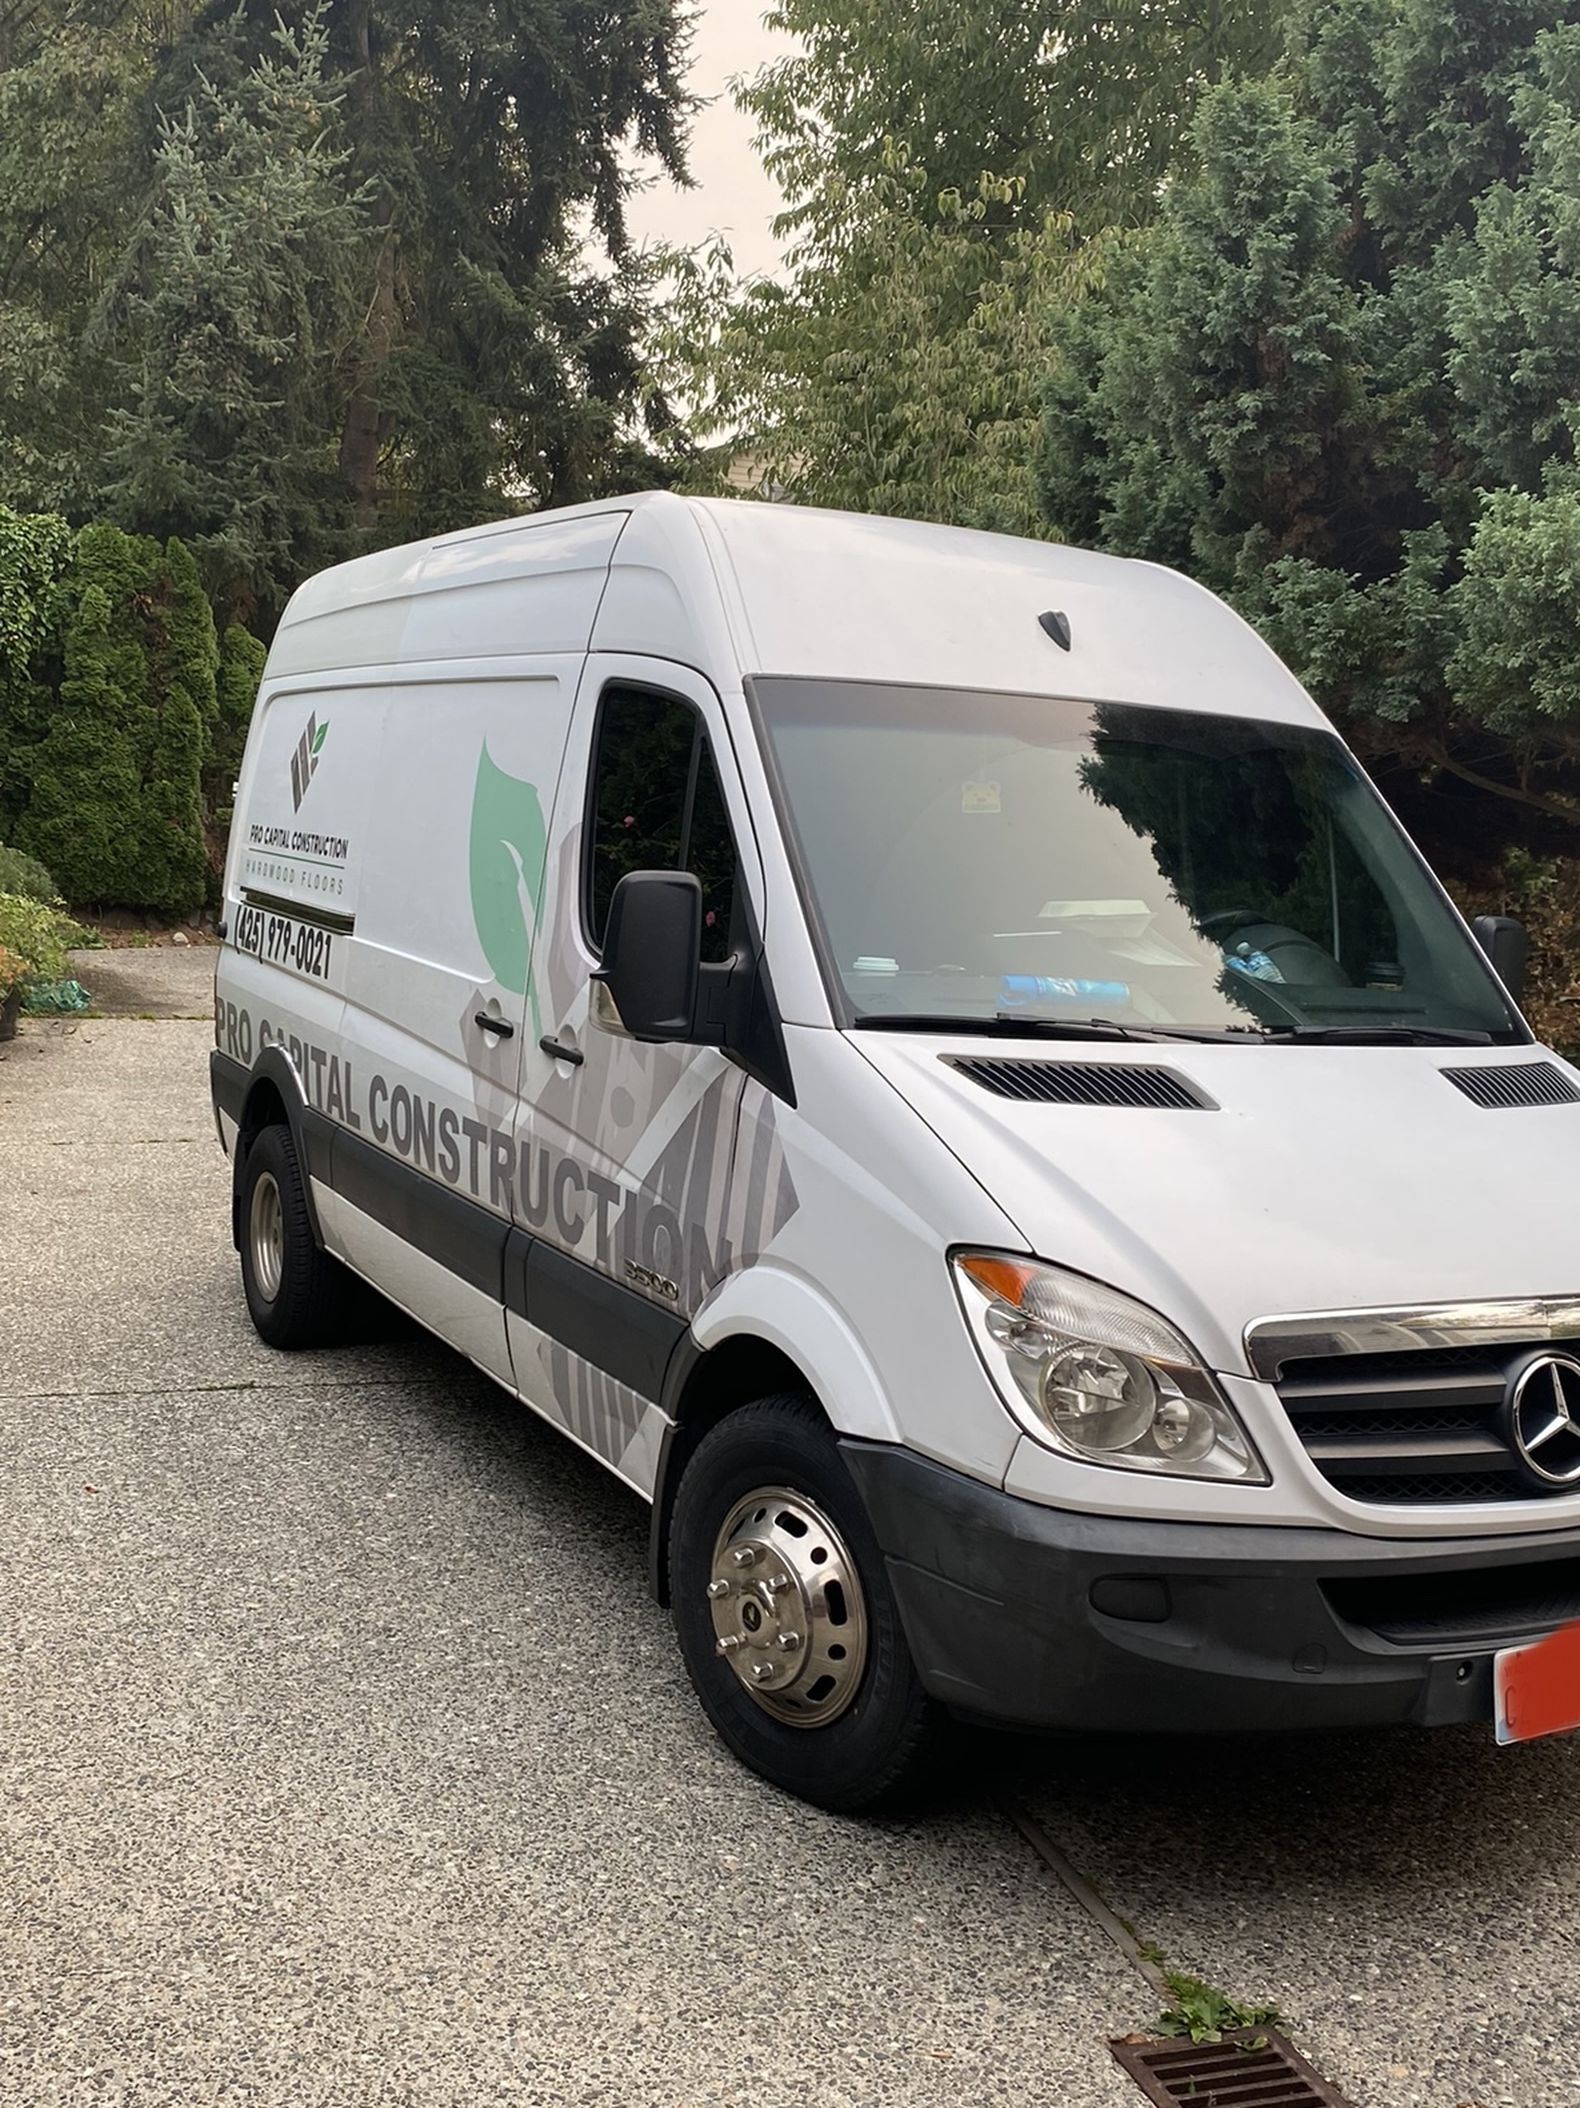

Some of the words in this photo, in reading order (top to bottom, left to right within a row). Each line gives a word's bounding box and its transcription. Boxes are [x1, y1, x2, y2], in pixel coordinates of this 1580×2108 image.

[249, 824, 263, 843] PRO
[264, 827, 290, 849] CAPITAL
[292, 831, 349, 859] CONSTRUCTION
[245, 859, 295, 883] HARDWOOD
[301, 871, 343, 895] FLOORS
[235, 905, 265, 964] (425)
[268, 916, 331, 979] 979-0021
[216, 997, 252, 1065] PRO
[369, 1074, 733, 1316] CONSTRUCTION
[623, 1256, 680, 1301] 3500
